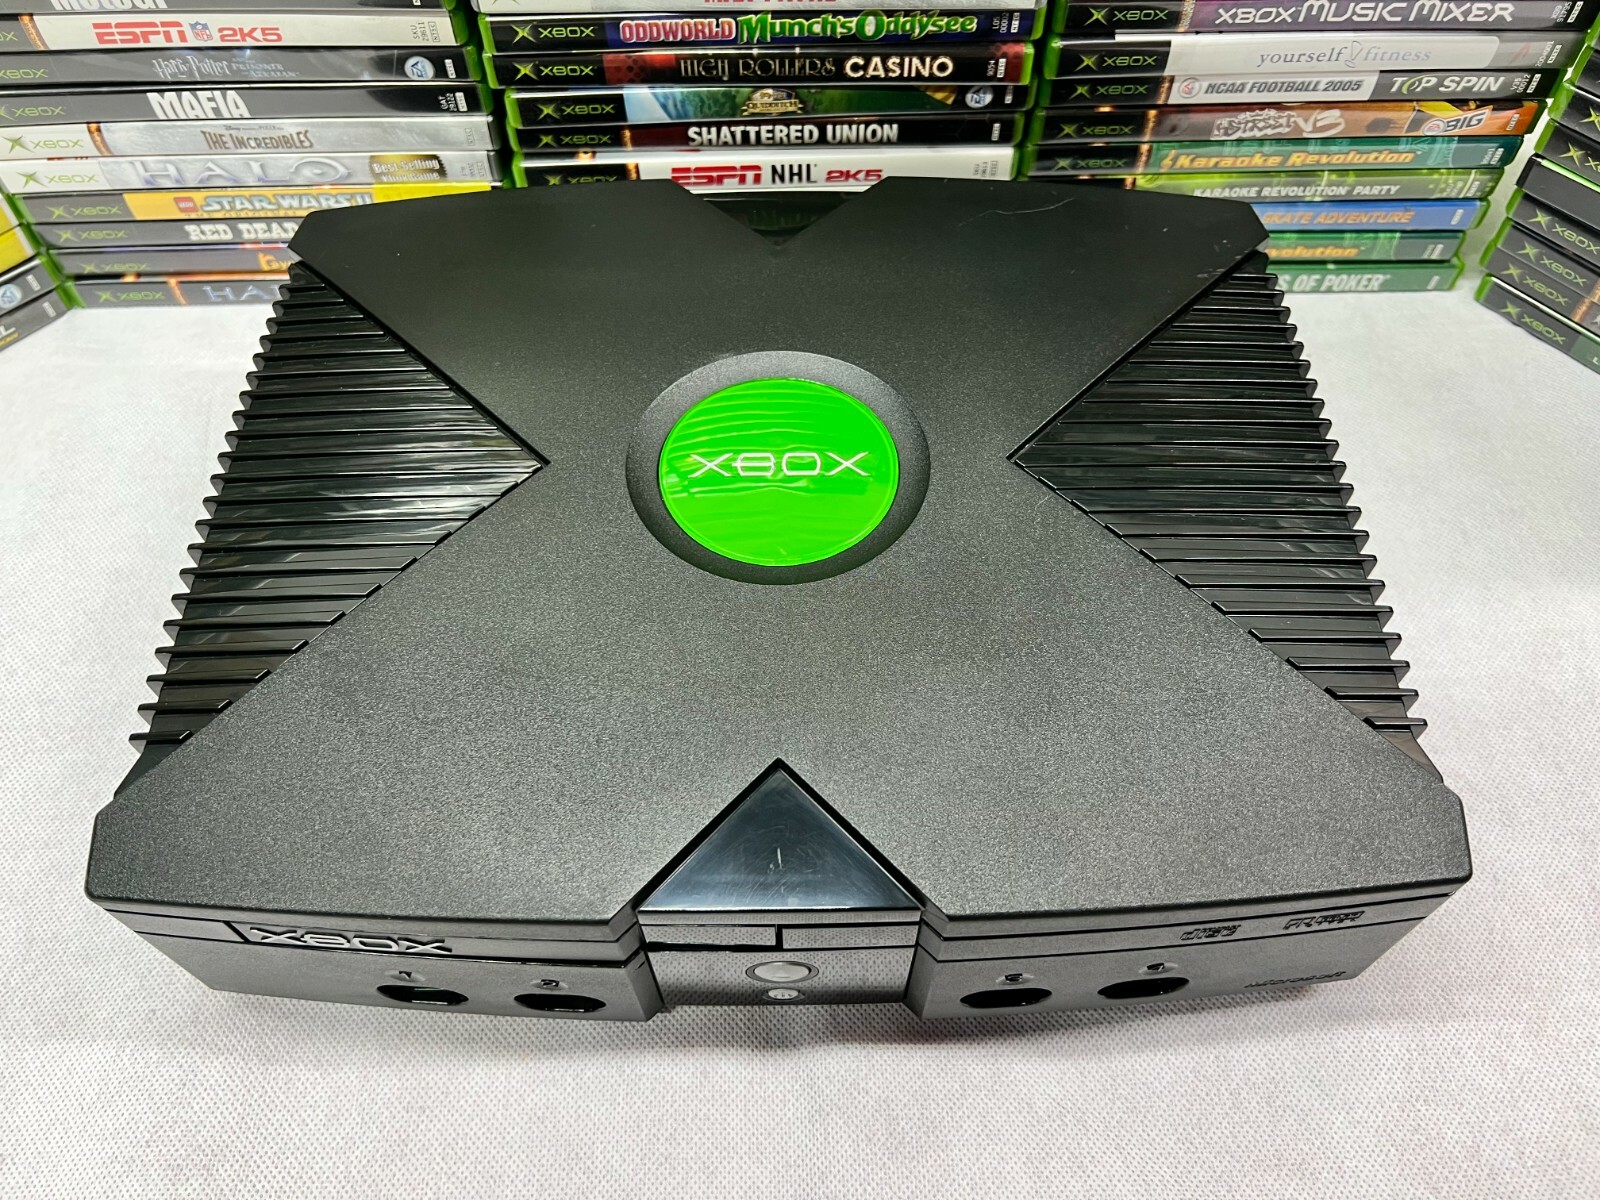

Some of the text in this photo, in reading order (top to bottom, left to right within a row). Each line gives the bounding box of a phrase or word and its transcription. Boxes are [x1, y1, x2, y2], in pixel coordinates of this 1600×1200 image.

[1113, 10, 1168, 21] XBOX
[1214, 7, 1297, 24] XBOX
[1300, 0, 1403, 22] MUSIC
[1409, 0, 1515, 22] MIXER
[92, 21, 188, 44] ESPN
[218, 27, 283, 42] 2K5
[410, 24, 420, 39] SKU
[428, 21, 441, 42] NTSC
[538, 26, 595, 38] XBOX
[620, 9, 977, 44] ODDWORLD Munch's Oddysee
[1102, 55, 1157, 66] XBOX
[1257, 46, 1431, 67] yourself fitness
[185, 56, 232, 81] Potter
[540, 65, 594, 76] XBOX
[680, 56, 954, 80] HIGH ROLLERS CASINO
[1096, 84, 1148, 95] XBOX
[1204, 82, 1249, 94] NCAA
[1248, 80, 1322, 94] FOOTBALL
[1323, 79, 1364, 92] 2005
[1390, 74, 1506, 94] TOP SPIN
[11, 106, 66, 117] XBOX
[146, 91, 251, 119] MAFIA
[562, 104, 616, 115] XBOX
[1082, 125, 1135, 135] XBOX
[1295, 109, 1346, 139] V3
[1445, 111, 1486, 132] BIG
[31, 138, 84, 149] XBOX
[201, 130, 231, 150] THE
[560, 134, 612, 144] XBOX
[687, 123, 899, 146] SHATTERED UNION
[372, 159, 440, 174] Best Selling
[1077, 158, 1127, 168] XBOX
[1173, 150, 1415, 170] Karaoke Revolution
[44, 174, 99, 184] XBOX
[130, 157, 351, 187] HALO
[671, 163, 883, 185] ESPN NHL 2K5
[1193, 184, 1400, 198] KARAOKE REVOLUTION PARTY
[70, 206, 123, 216] XBOX
[202, 195, 278, 212] STAR
[274, 193, 351, 211] WARS
[1263, 211, 1416, 225] SKATE ADVENTURE
[78, 230, 129, 240] XBOX
[184, 224, 233, 241] RED
[1552, 223, 1600, 255] XBOX
[1265, 246, 1361, 258] volution
[102, 262, 150, 271] XBOX
[1540, 255, 1587, 287] XBOX
[1293, 275, 1318, 291] OF
[1319, 273, 1386, 292] POKER
[1522, 276, 1568, 306] XBOX
[117, 291, 165, 300] XBOX
[202, 285, 282, 301] HAL
[1520, 314, 1566, 345] XBOX
[688, 452, 871, 478] XBOX
[250, 926, 452, 954] XBOX
